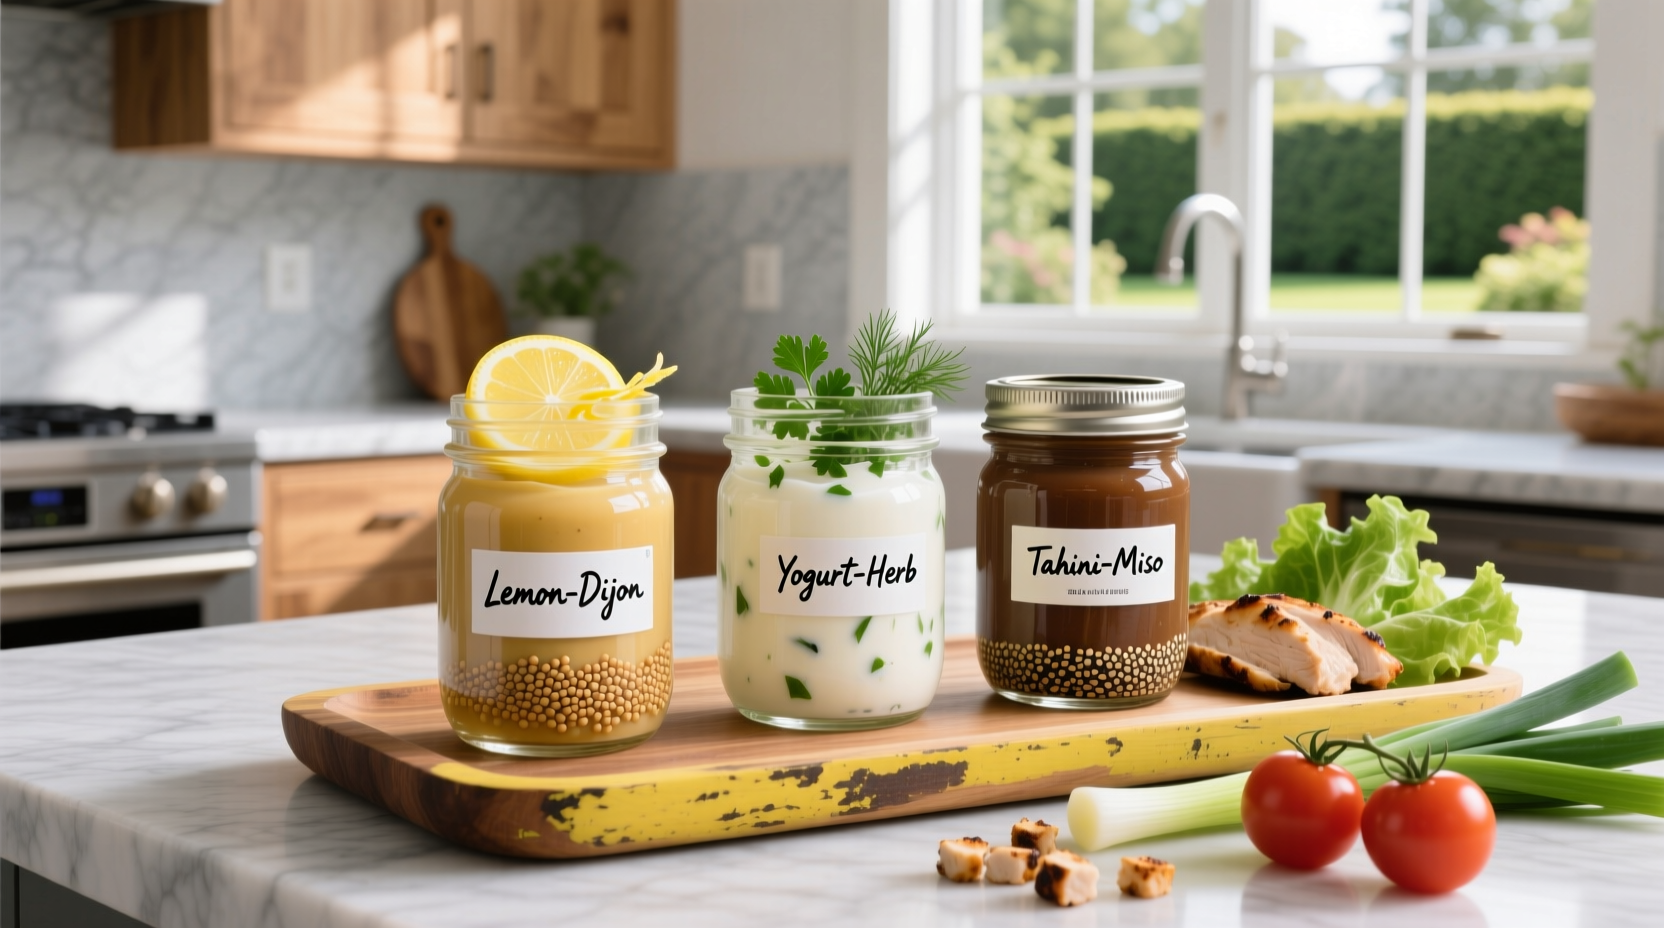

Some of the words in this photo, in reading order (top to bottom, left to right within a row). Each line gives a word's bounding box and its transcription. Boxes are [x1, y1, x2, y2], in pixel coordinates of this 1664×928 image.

[777, 553, 917, 602] Yogurt-Herb
[1027, 545, 1164, 577] Tahini-Miso
[484, 570, 644, 620] Lemon-Dijon
